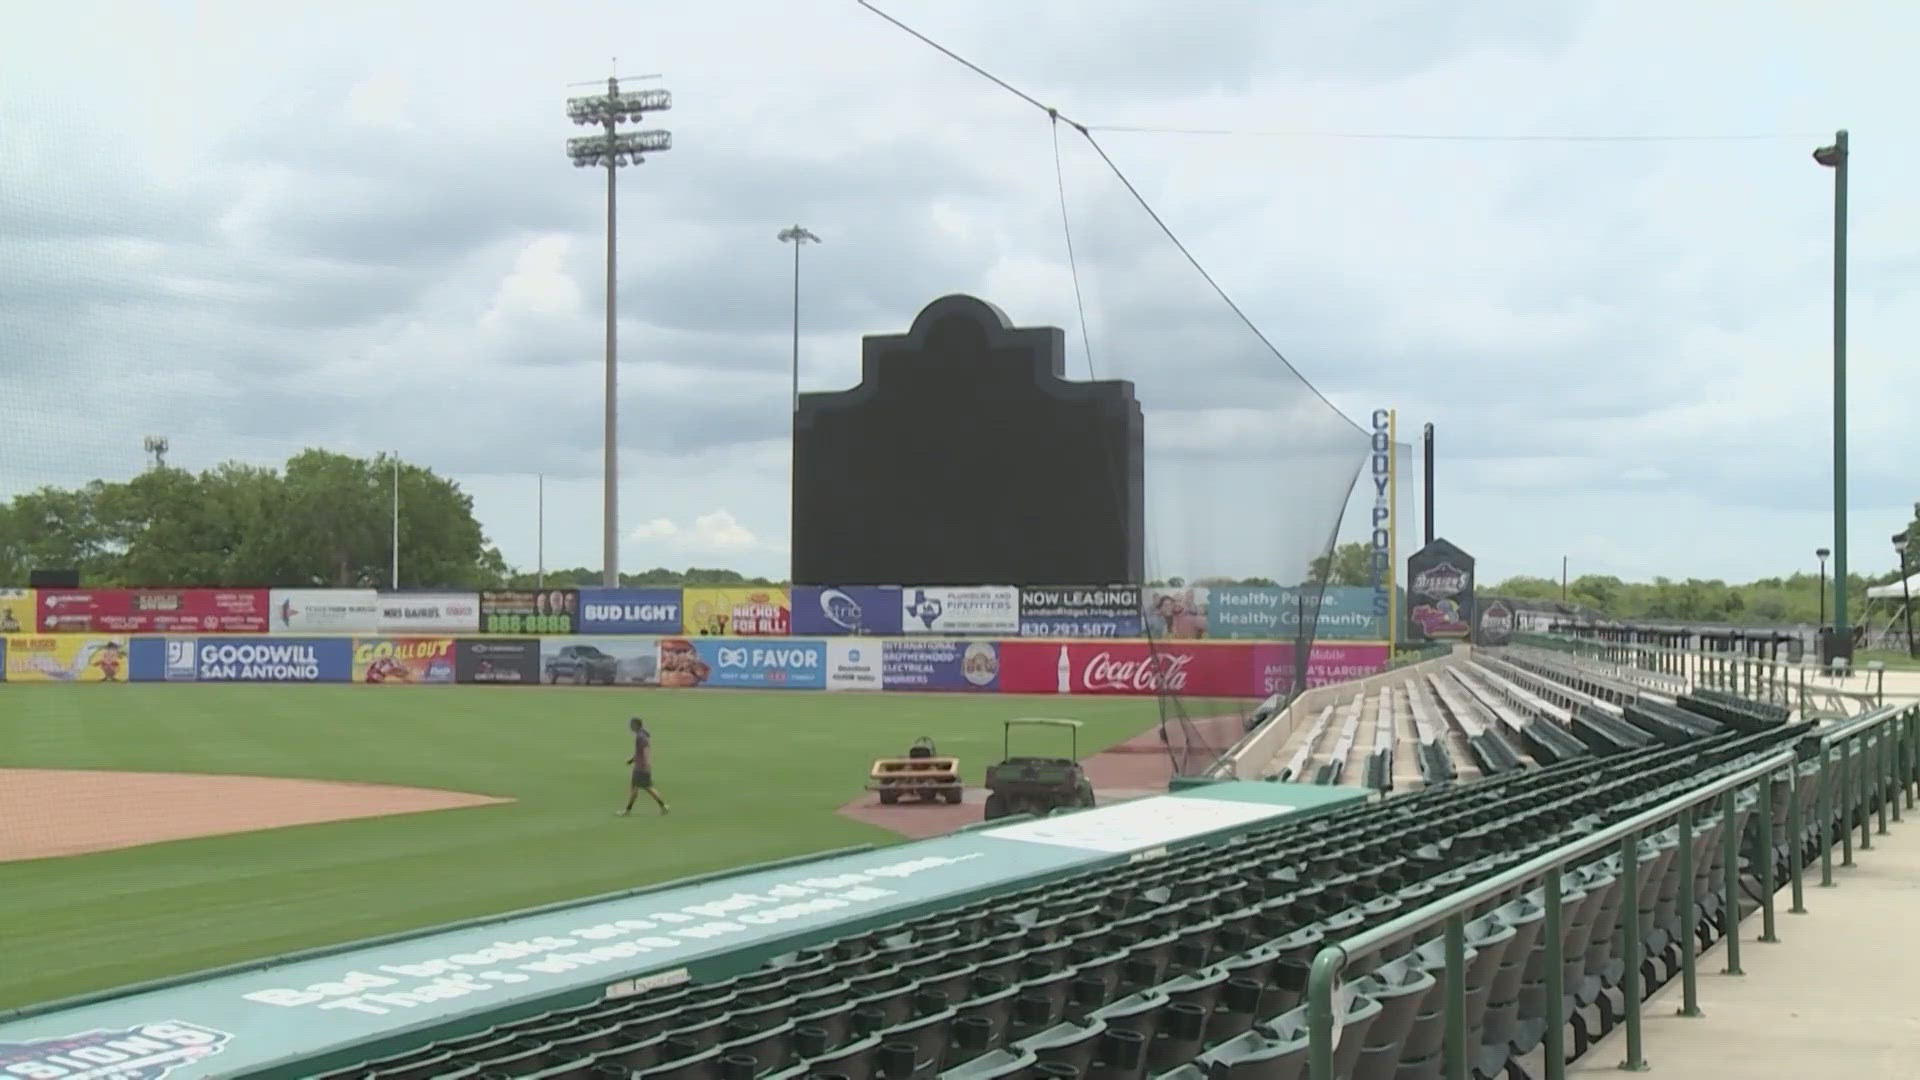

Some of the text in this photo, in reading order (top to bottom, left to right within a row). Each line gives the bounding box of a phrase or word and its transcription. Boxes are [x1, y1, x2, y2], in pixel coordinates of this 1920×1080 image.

[1022, 590, 1137, 606] NOW LEASING!
[1219, 591, 1339, 608] Healthy People.
[585, 605, 677, 621] BUD LIGHT
[732, 604, 781, 618] NACHOS
[1219, 610, 1375, 628] Healthy Community.
[733, 618, 787, 631] FOR ALL!
[201, 645, 318, 664] GOODWILL
[356, 641, 454, 663] GO ALL OUT
[752, 649, 818, 668] FAVOR
[202, 665, 240, 678] SAN
[243, 664, 319, 680] ANTONIO
[883, 664, 934, 673] ELECTRICAL
[1083, 652, 1194, 691] Coca-Cola
[1264, 665, 1378, 676] AMERA'S LARGEST
[517, 937, 682, 974] where
[668, 920, 748, 939] we
[242, 970, 400, 1008] Bad
[569, 919, 658, 940] are
[0, 1024, 218, 1080] SIONS
